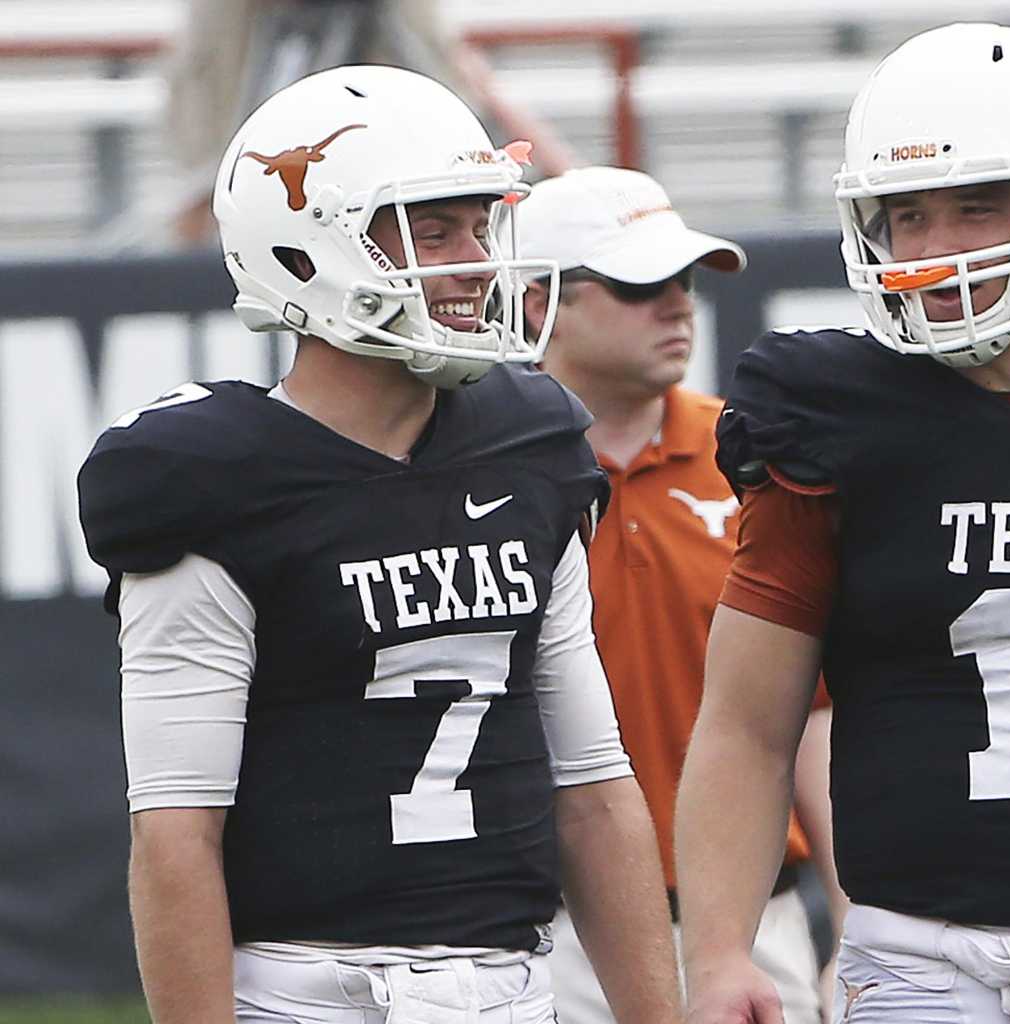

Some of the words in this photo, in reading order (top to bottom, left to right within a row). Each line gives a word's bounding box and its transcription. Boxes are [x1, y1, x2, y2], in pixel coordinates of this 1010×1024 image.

[890, 143, 938, 162] HORNS
[339, 540, 538, 633] TEXAS
[364, 630, 517, 844] 7
